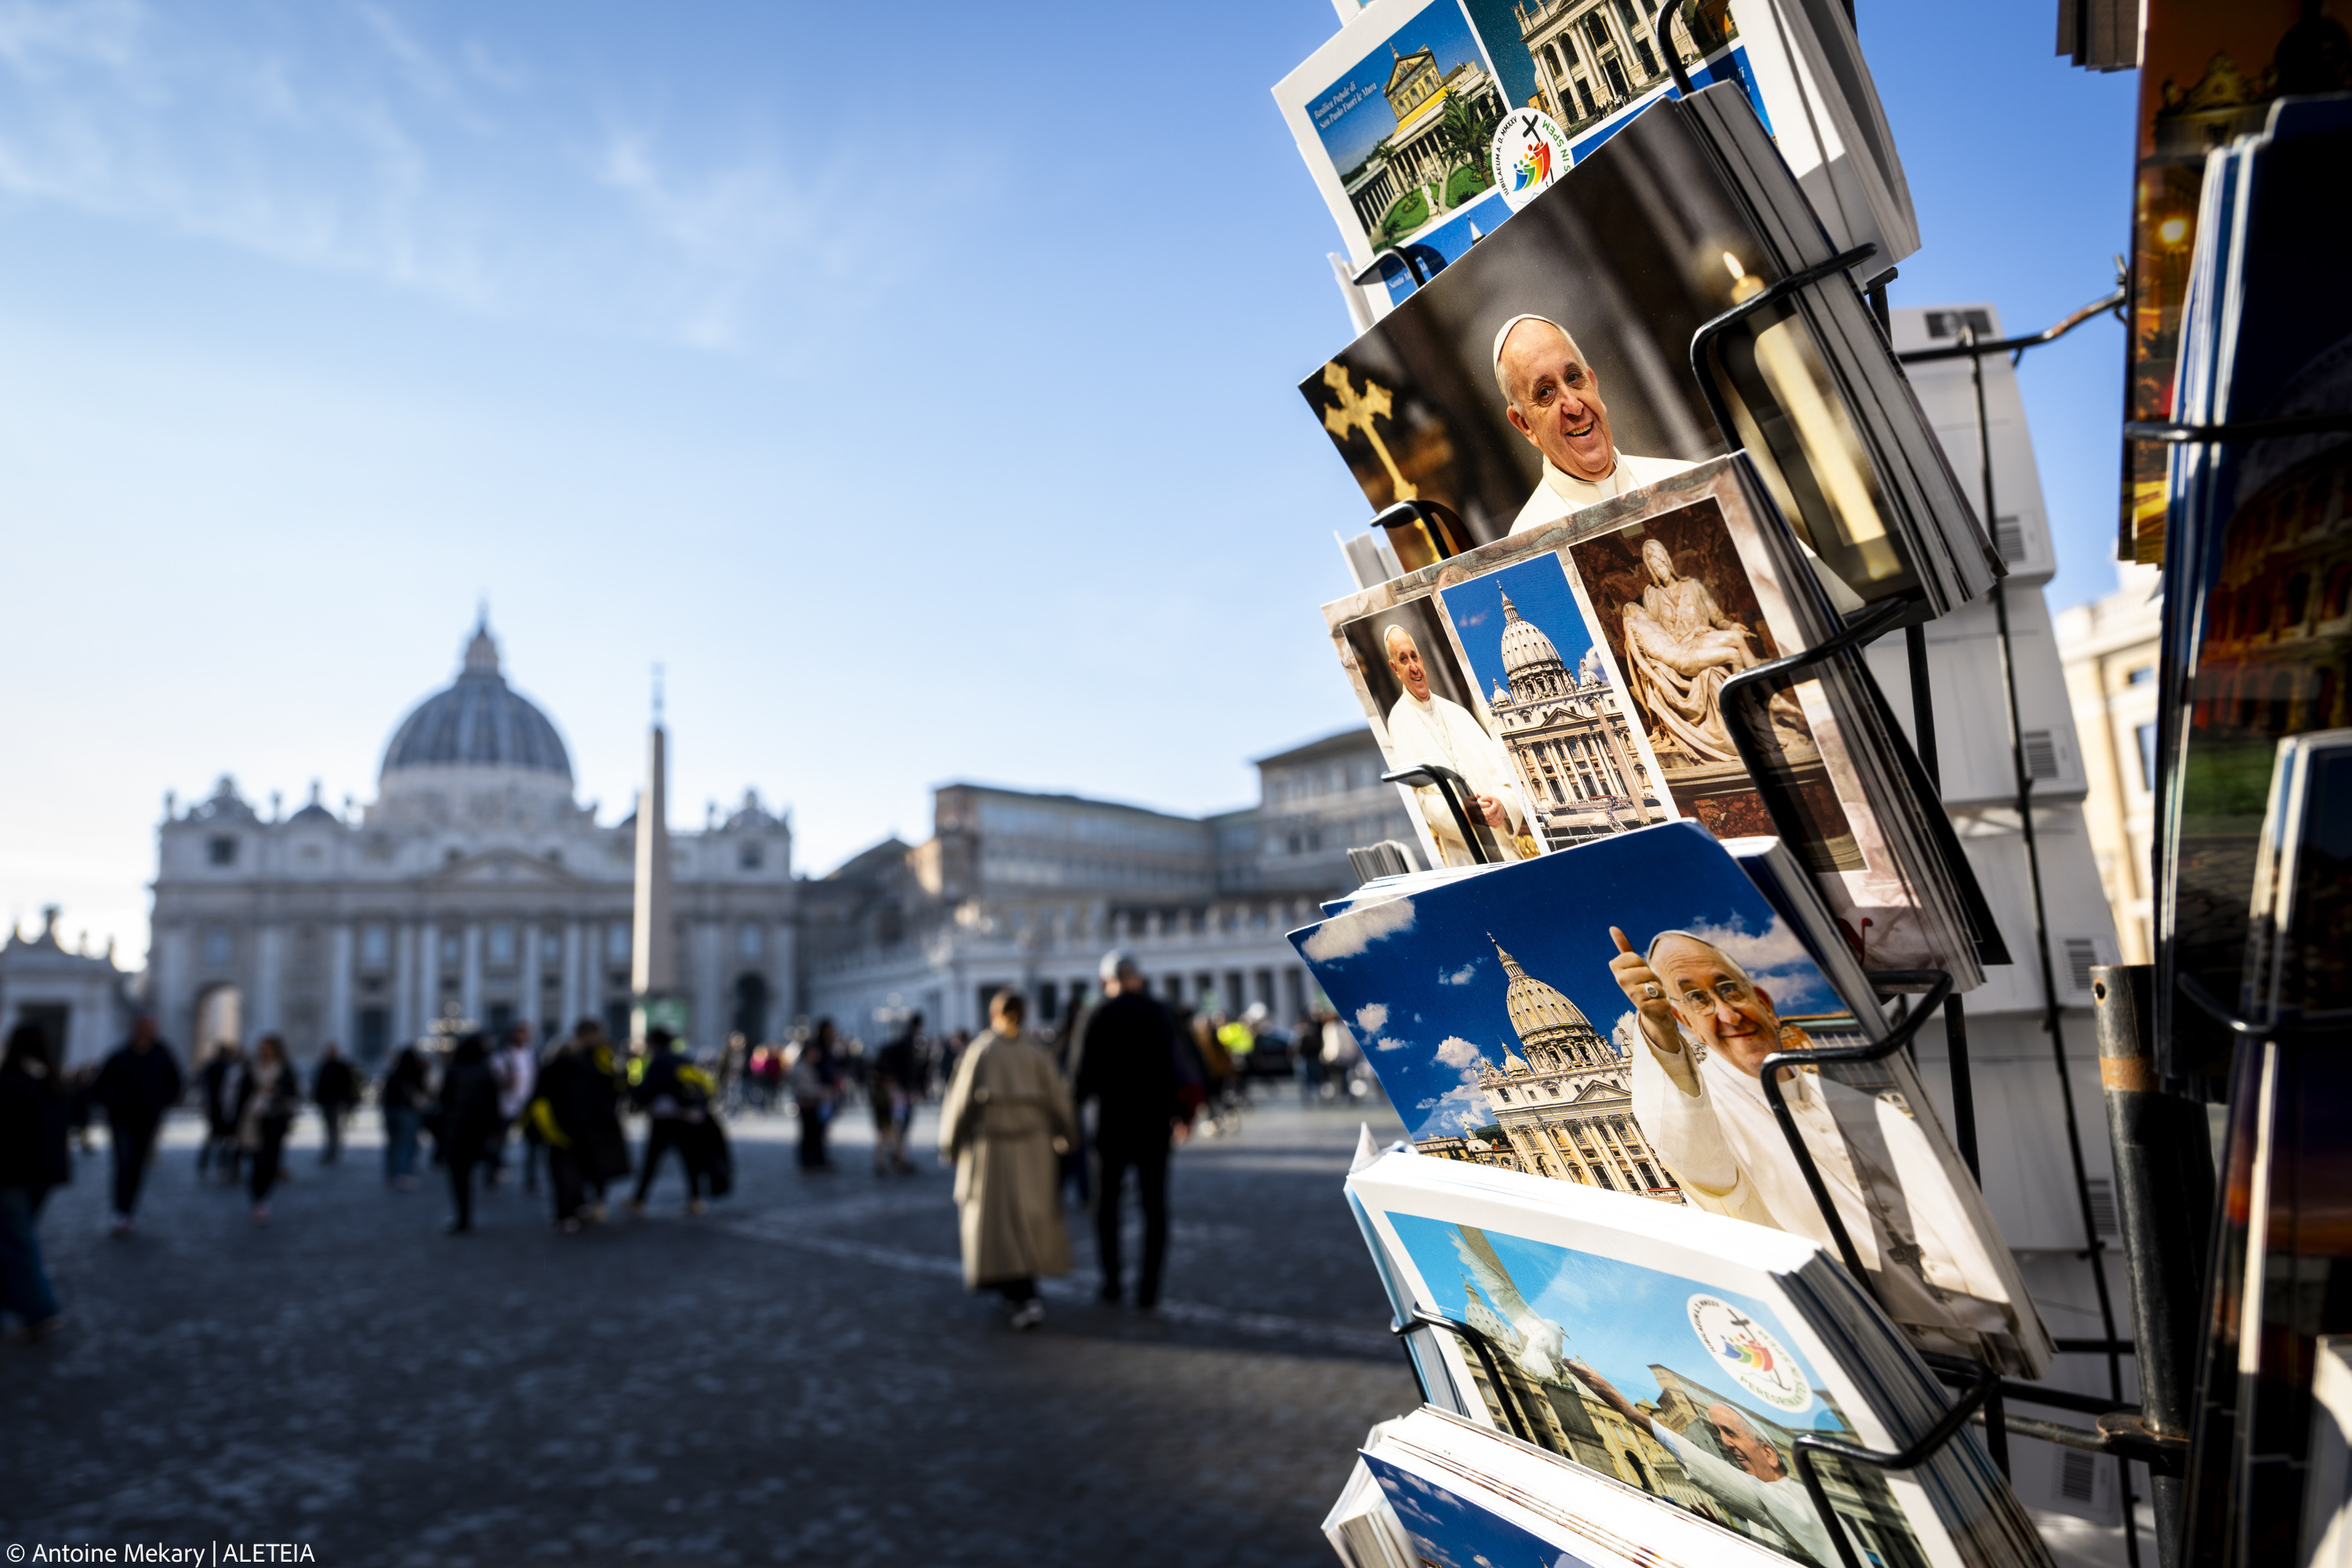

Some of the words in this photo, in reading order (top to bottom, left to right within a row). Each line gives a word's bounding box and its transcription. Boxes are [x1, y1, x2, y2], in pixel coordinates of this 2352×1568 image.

[1313, 100, 1334, 120] Basilica
[1333, 87, 1350, 105] Papale
[1349, 81, 1356, 92] di
[1319, 118, 1330, 130] San
[1329, 107, 1344, 123] Paolo
[1342, 95, 1358, 113] Fuori
[1356, 93, 1363, 102] le
[1361, 82, 1377, 97] Mura
[1501, 115, 1518, 137] MMXXV
[1541, 119, 1565, 148] SPEM
[1560, 148, 1570, 162] IN
[1495, 153, 1510, 196] IUBILAEUM
